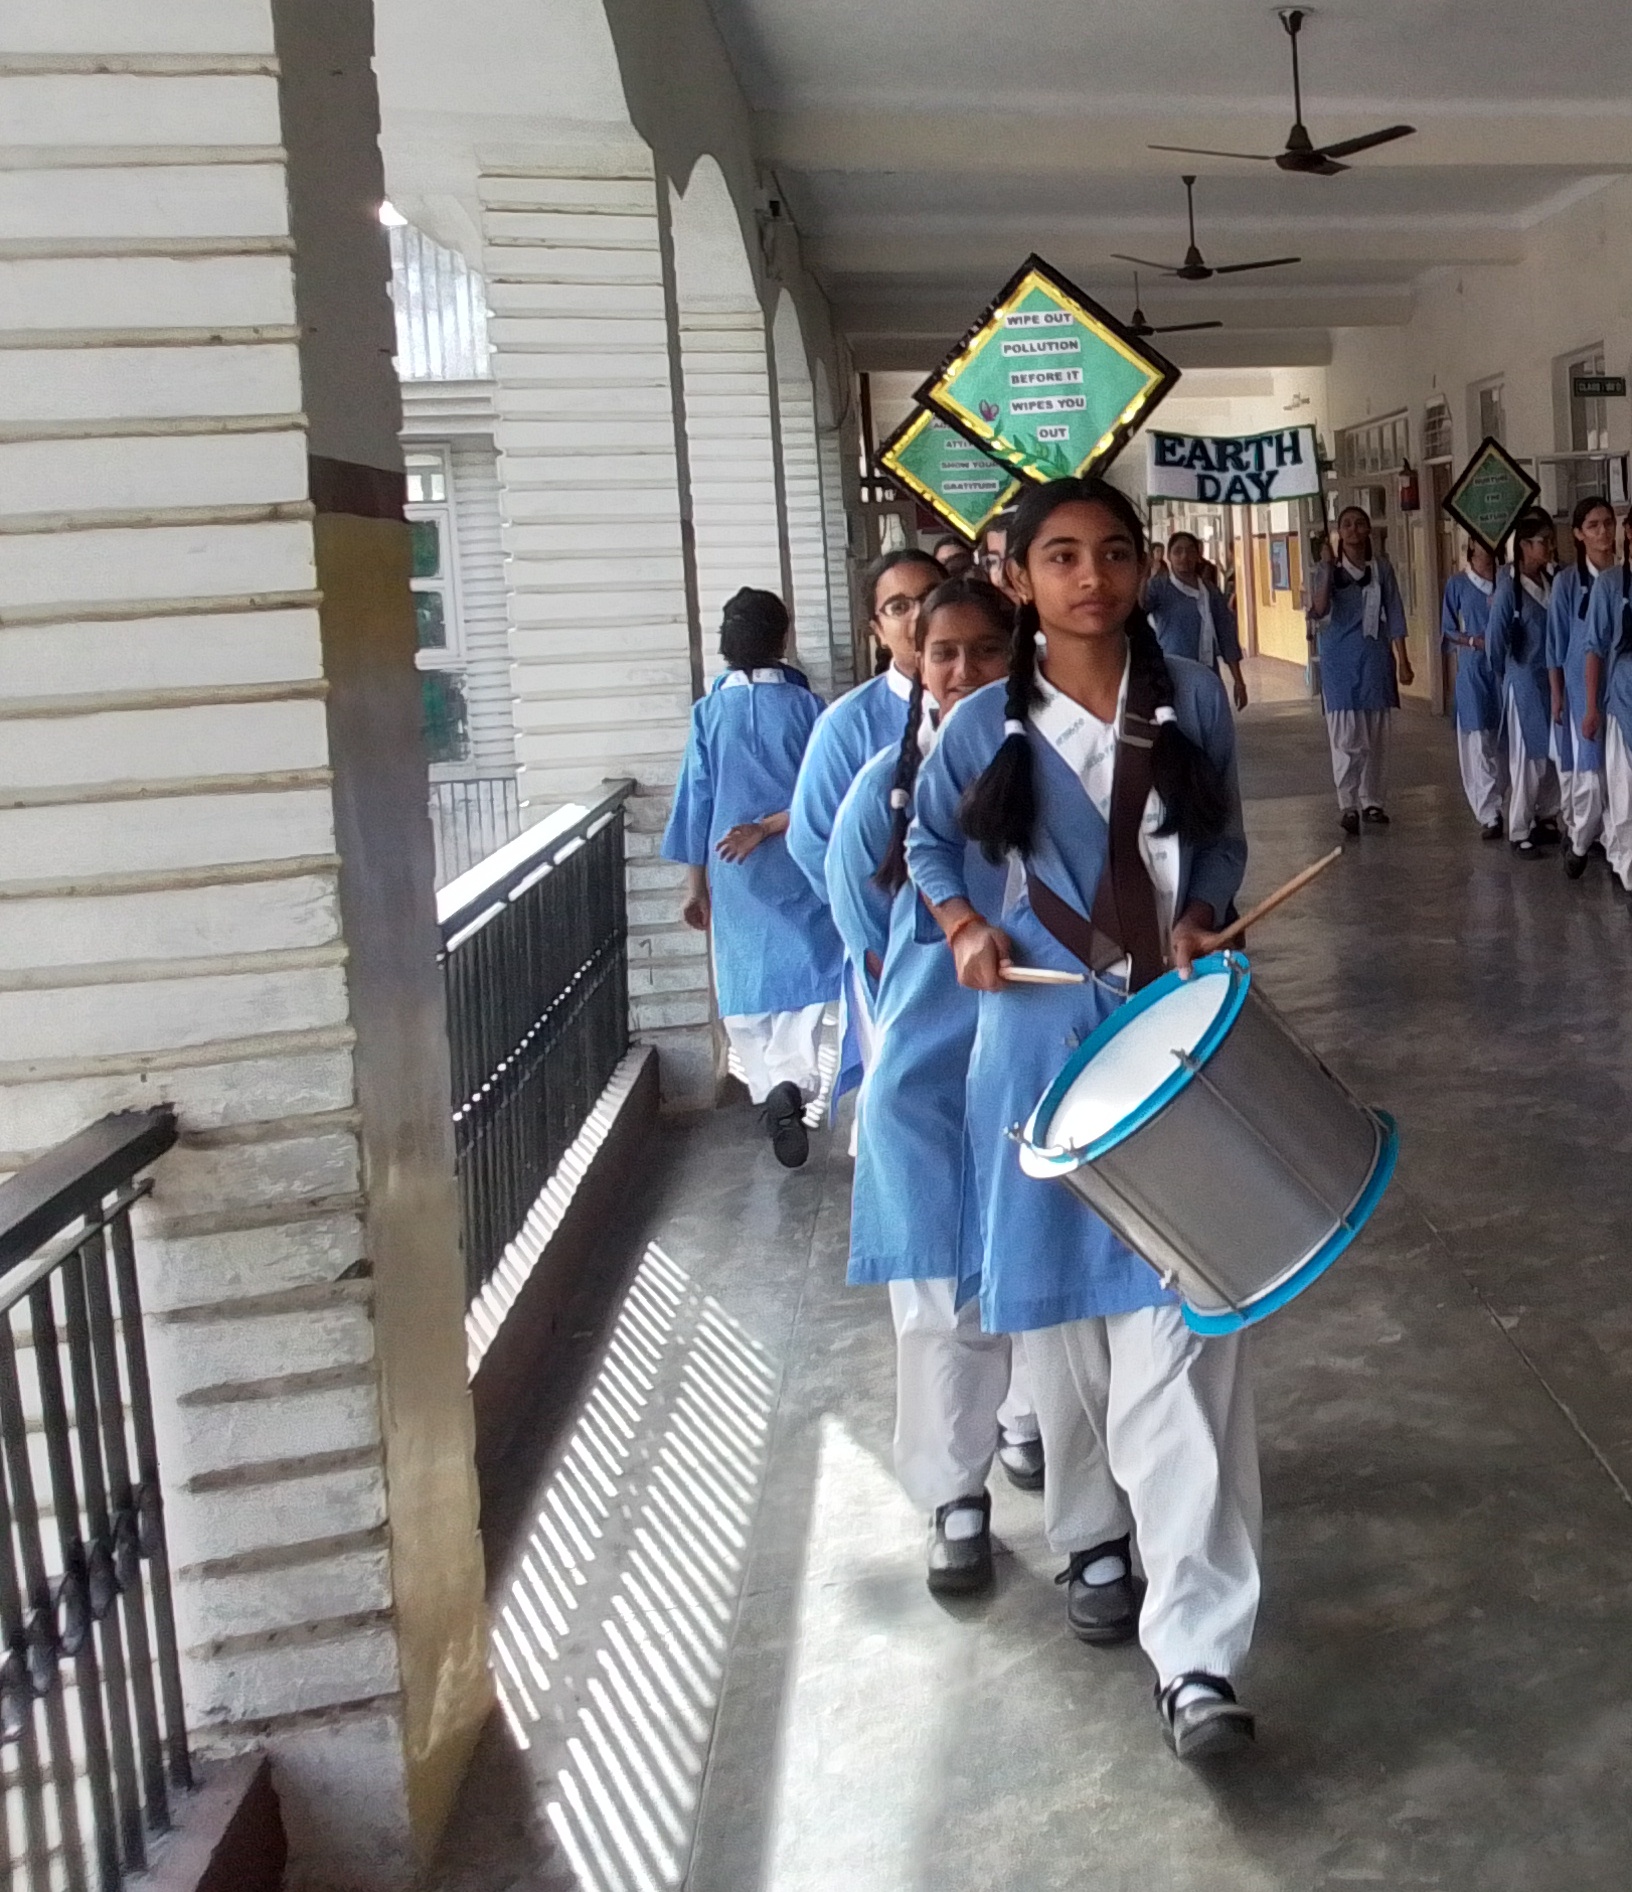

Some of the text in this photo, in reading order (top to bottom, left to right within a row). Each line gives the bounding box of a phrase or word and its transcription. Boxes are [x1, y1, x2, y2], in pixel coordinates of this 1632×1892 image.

[1006, 313, 1072, 326] WIPE OUT
[1003, 339, 1079, 354] POLLUTION
[1010, 370, 1079, 385] BEFORE IT
[1011, 397, 1085, 412] WIPES YOU
[1038, 428, 1067, 439] OUT
[1153, 429, 1304, 473] EARTH
[941, 461, 970, 469] SHOW
[943, 482, 997, 491] GRATITUDE
[1195, 470, 1280, 504] DAY
